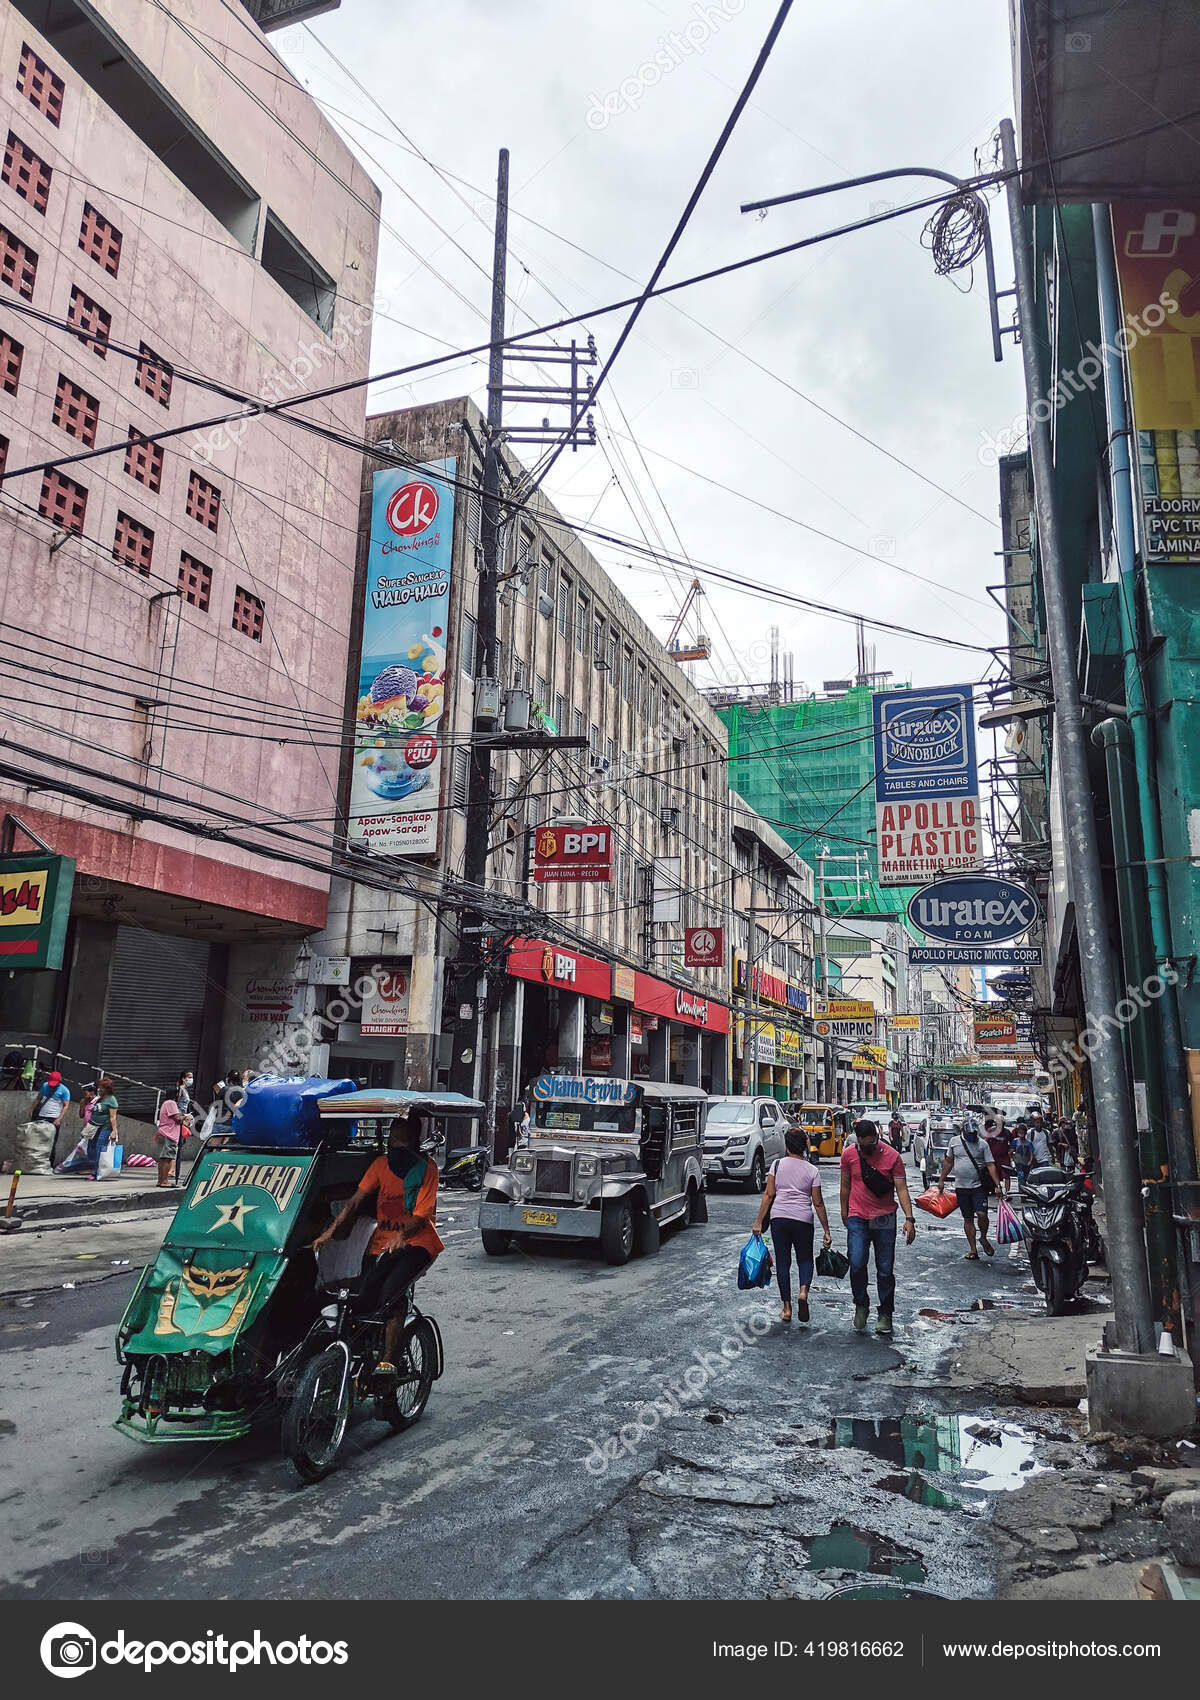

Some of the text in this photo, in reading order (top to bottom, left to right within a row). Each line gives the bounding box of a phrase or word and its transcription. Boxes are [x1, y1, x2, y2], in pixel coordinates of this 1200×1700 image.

[1152, 519, 1180, 532] PVC
[1147, 539, 1200, 552] LAMINA
[371, 582, 448, 609] HALO-HALO
[890, 736, 959, 761] MONOBLOCK
[884, 776, 969, 790] TABLES AND CHAIRS
[358, 814, 433, 826] Apaw-Sangkap,
[881, 800, 975, 832] APOLLO
[362, 824, 427, 837] Apaw-Sarap!
[564, 832, 606, 854] BPI
[881, 829, 977, 858] PLASTIC
[881, 856, 978, 872] MARKETING CORP.
[955, 930, 992, 939] FOAM
[912, 950, 1040, 961] APOLLO PLASTIC MKTG. CORP.
[555, 953, 577, 982] BPI
[829, 1002, 857, 1013] AMERICAN
[250, 1012, 289, 1022] THIS WAY
[361, 1025, 396, 1033] STRAIGHT
[832, 1022, 873, 1035] NMPMC
[979, 1029, 1003, 1038] Scratch
[188, 1163, 304, 1215] JERICHO
[229, 1205, 240, 1221] 1
